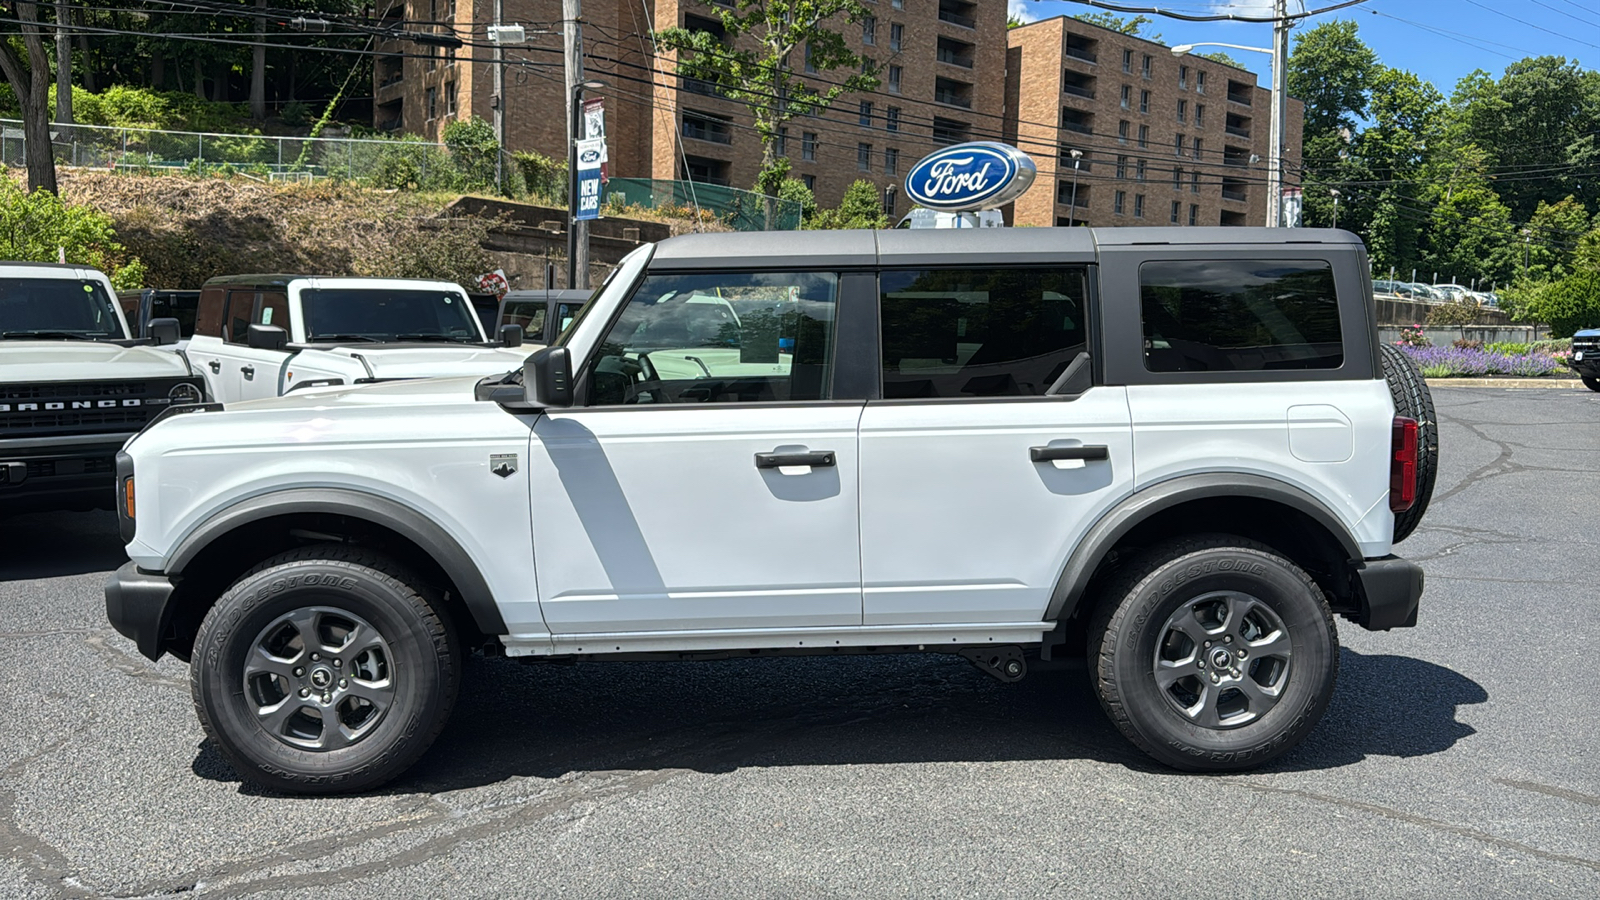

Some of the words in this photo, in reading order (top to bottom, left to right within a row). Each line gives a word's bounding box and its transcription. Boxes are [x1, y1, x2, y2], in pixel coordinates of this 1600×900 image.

[582, 151, 598, 162] Ford
[580, 178, 599, 196] NEW
[924, 156, 991, 198] Ford
[580, 195, 598, 210] CARS
[1126, 558, 1267, 651] BRIDGESTONE
[207, 572, 359, 671] BRIDGESTONE
